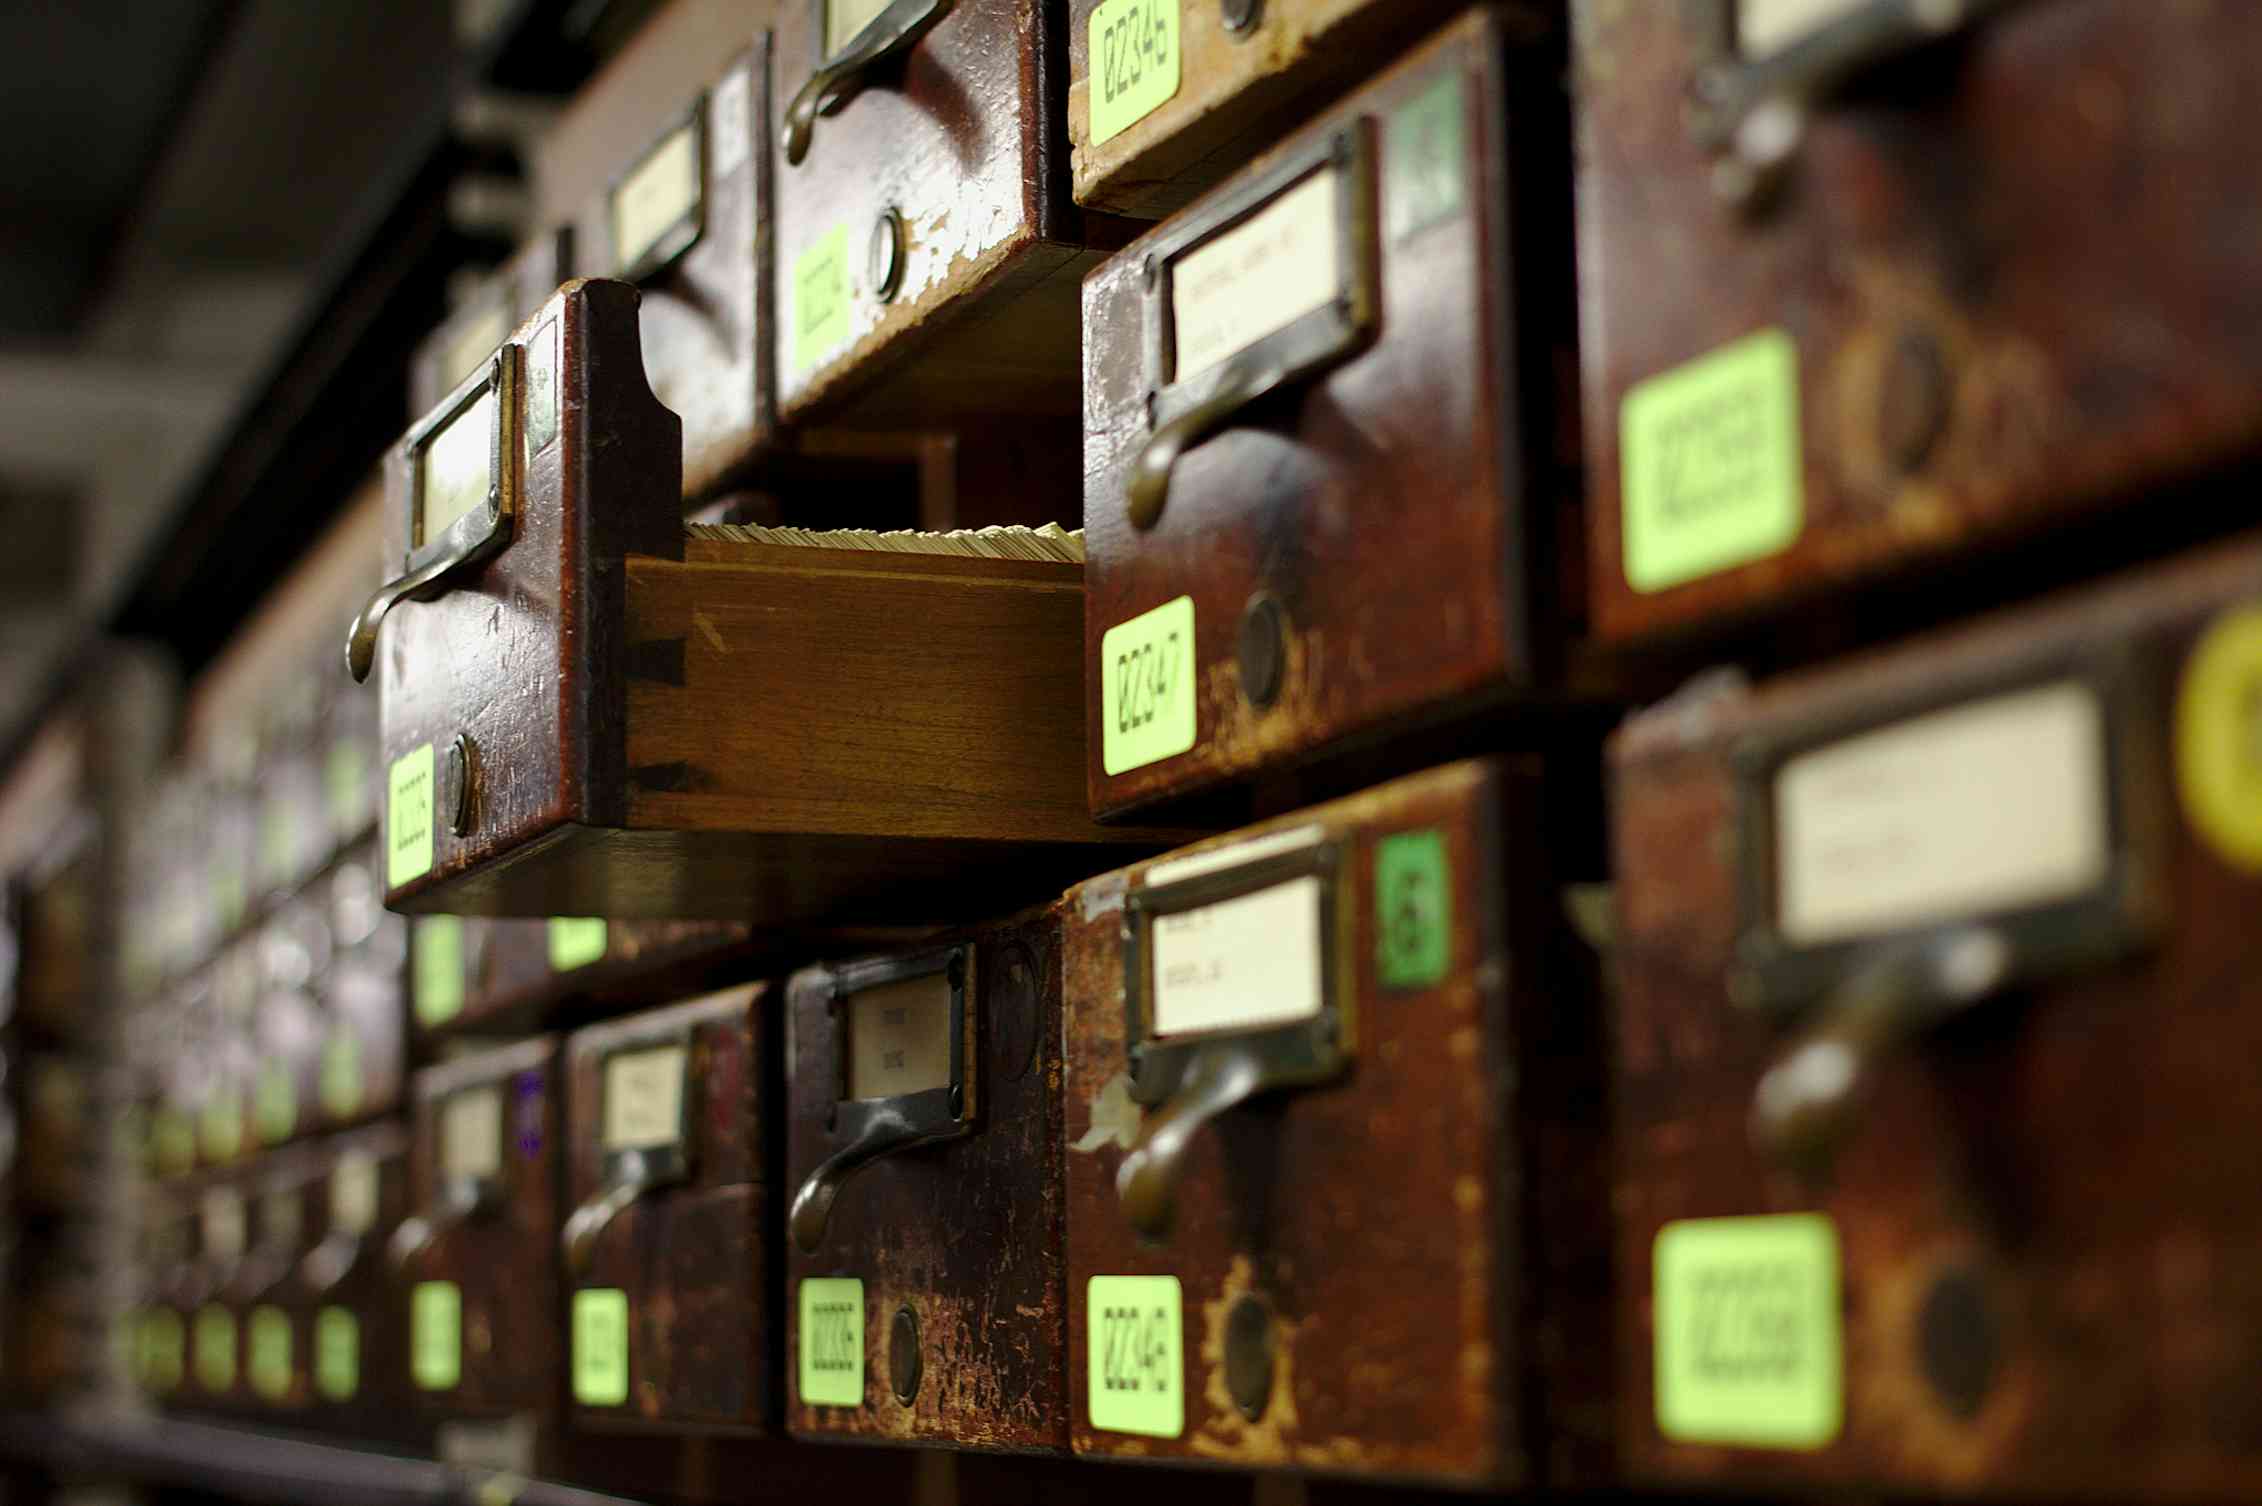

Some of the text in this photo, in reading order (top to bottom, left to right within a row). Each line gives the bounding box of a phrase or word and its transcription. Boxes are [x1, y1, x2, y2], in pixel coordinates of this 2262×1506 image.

[1104, 0, 1167, 103] 02346
[1117, 631, 1179, 735] 02347
[1103, 1307, 1168, 1392] 02348
